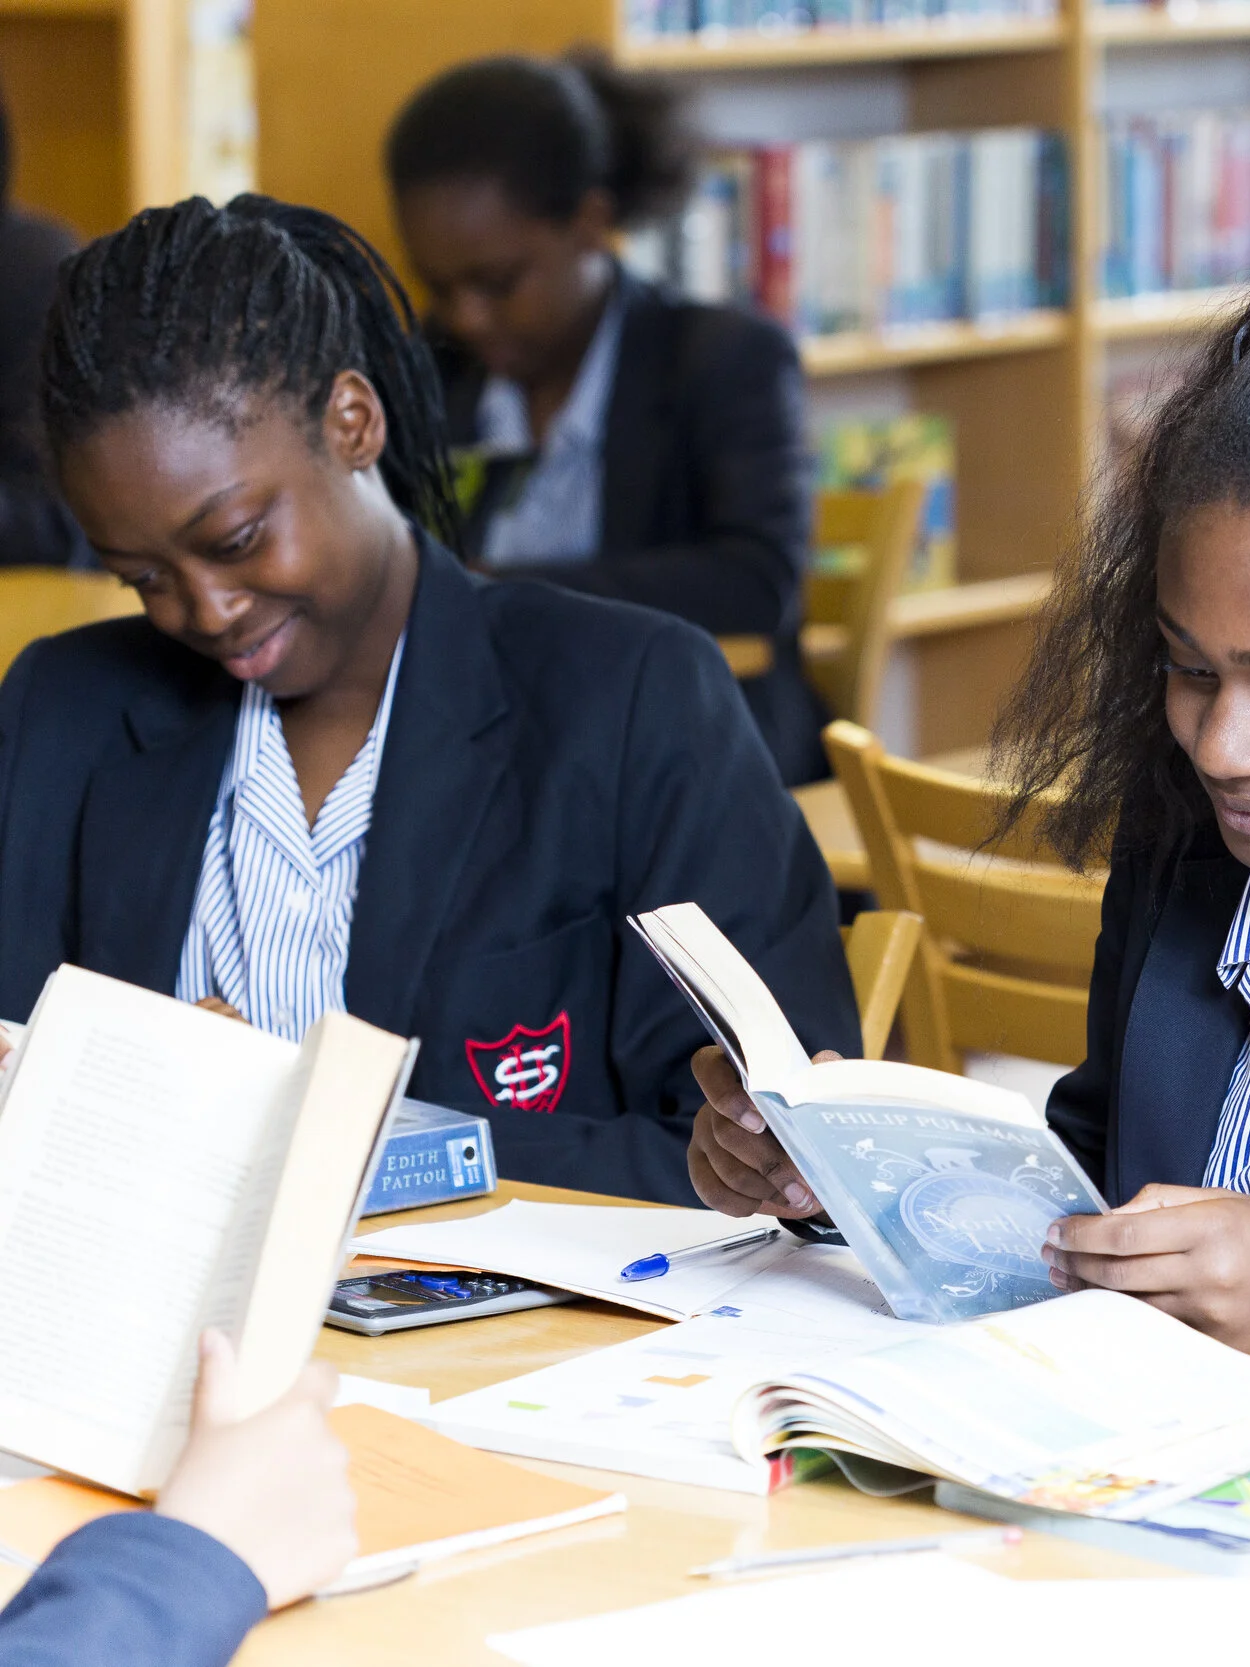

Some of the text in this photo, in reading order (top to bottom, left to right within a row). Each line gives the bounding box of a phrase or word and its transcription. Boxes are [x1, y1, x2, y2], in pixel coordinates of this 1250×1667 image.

[819, 1111, 909, 1127] PHILIP
[914, 1115, 1042, 1148] PULLMAN
[387, 1151, 439, 1172] EDITH
[382, 1168, 447, 1192] PATTOU
[922, 1204, 1047, 1240] North
